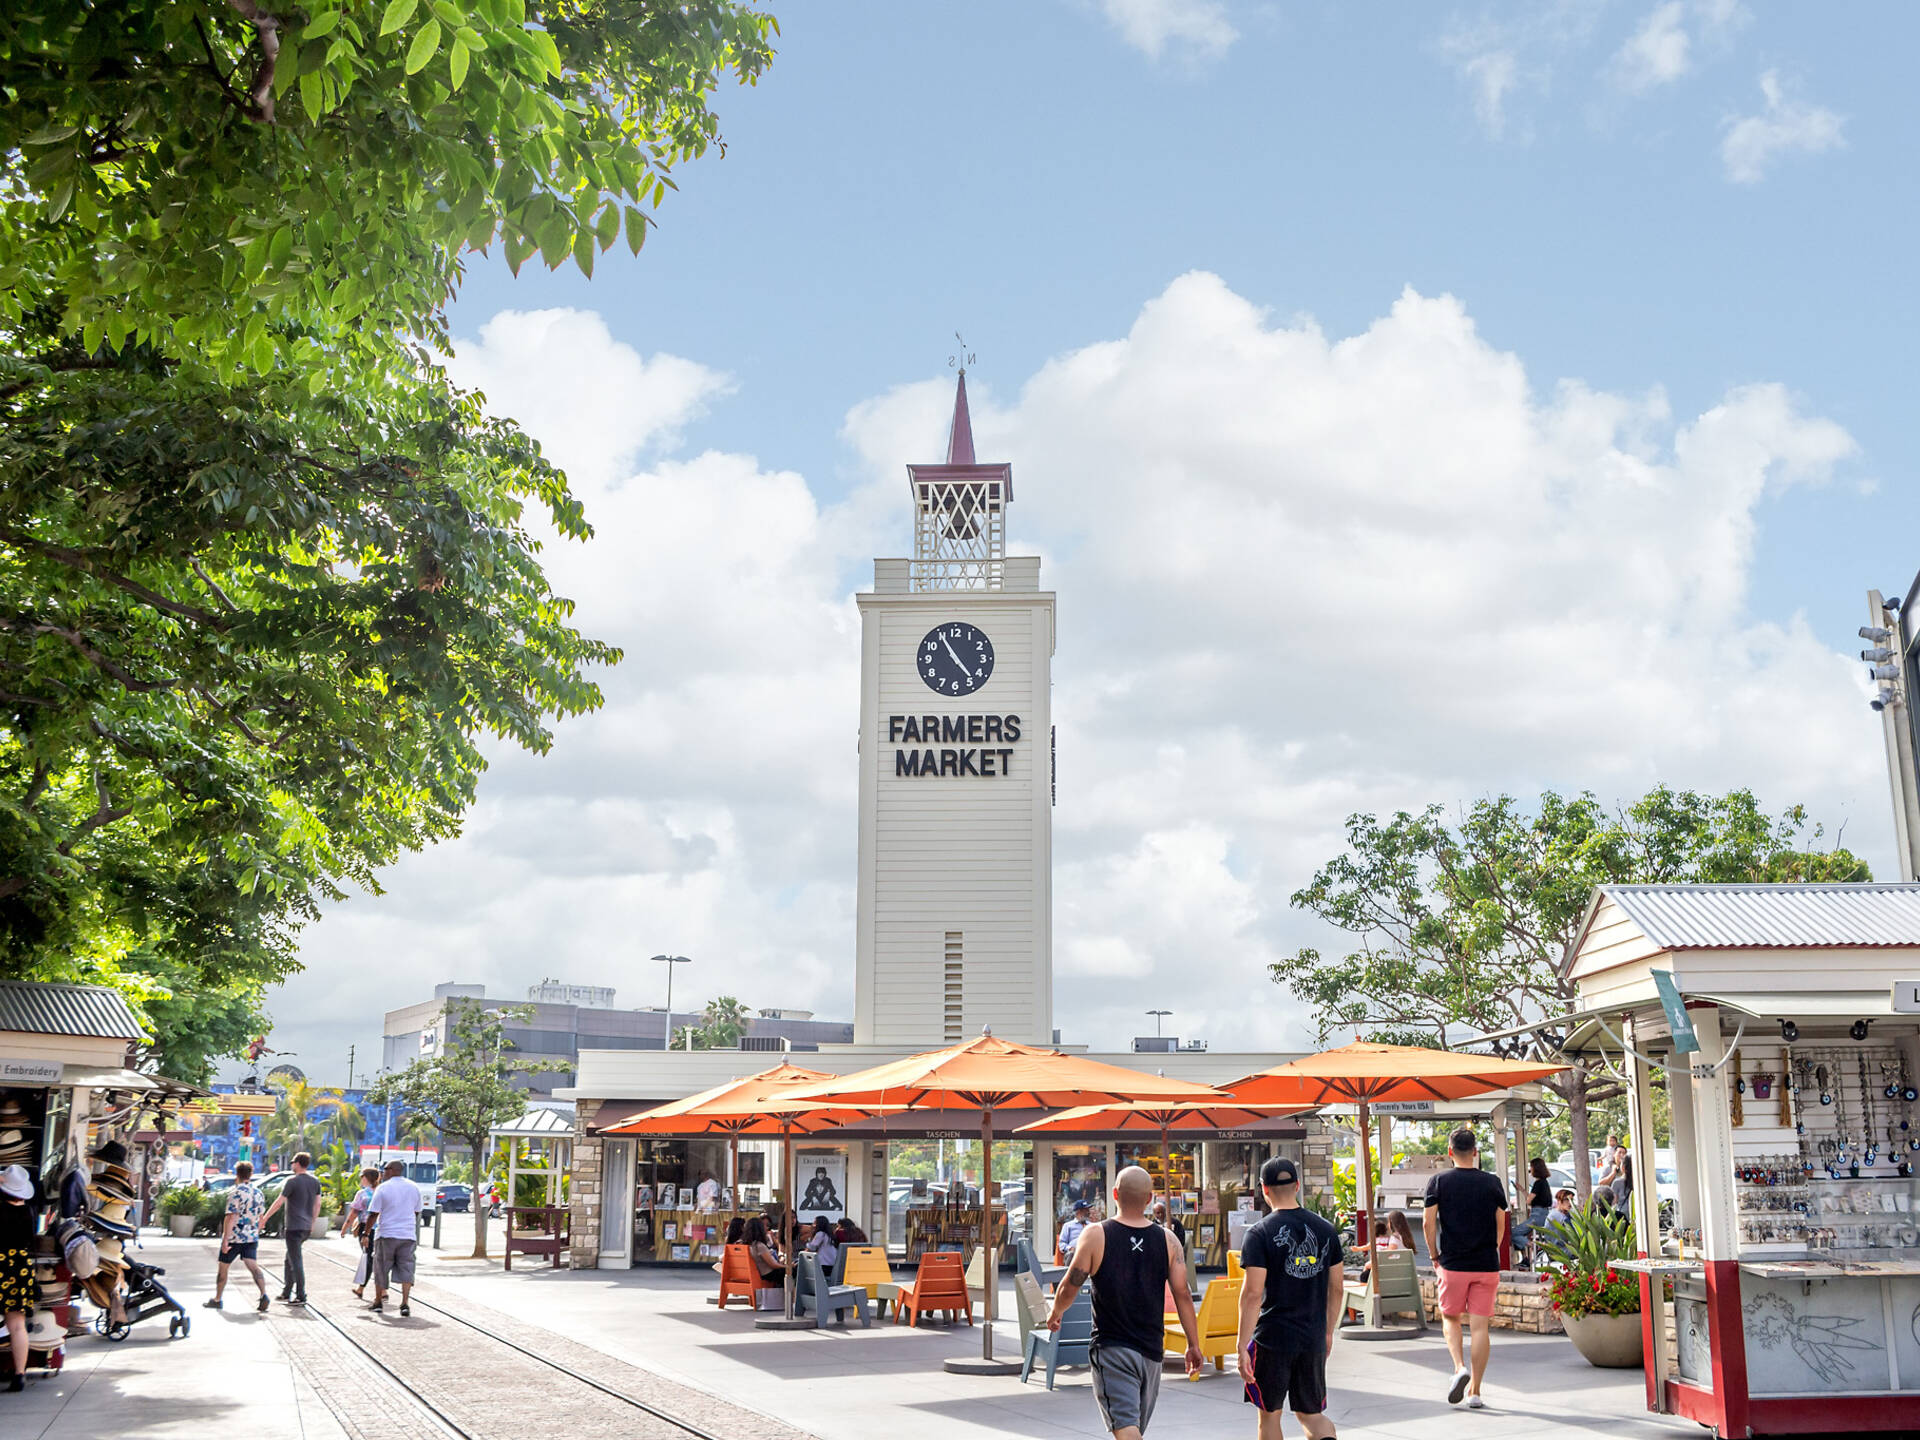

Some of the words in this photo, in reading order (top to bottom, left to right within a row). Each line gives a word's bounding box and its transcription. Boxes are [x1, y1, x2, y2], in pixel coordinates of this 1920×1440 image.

[950, 628, 961, 638] 12
[968, 631, 971, 640] 1
[927, 641, 937, 651] 10
[976, 641, 983, 650] 2
[924, 654, 932, 664] 9
[980, 654, 987, 663] 3
[928, 668, 935, 677] 8
[975, 668, 983, 677] 4
[939, 678, 946, 687] 7
[951, 681, 959, 690] 6
[966, 677, 973, 686] 5
[889, 715, 1021, 743] FARMERS
[895, 749, 1014, 777] MARKET
[4, 1064, 59, 1078] Embroidery
[1401, 1102, 1416, 1110] Yours
[1417, 1101, 1430, 1110] USA
